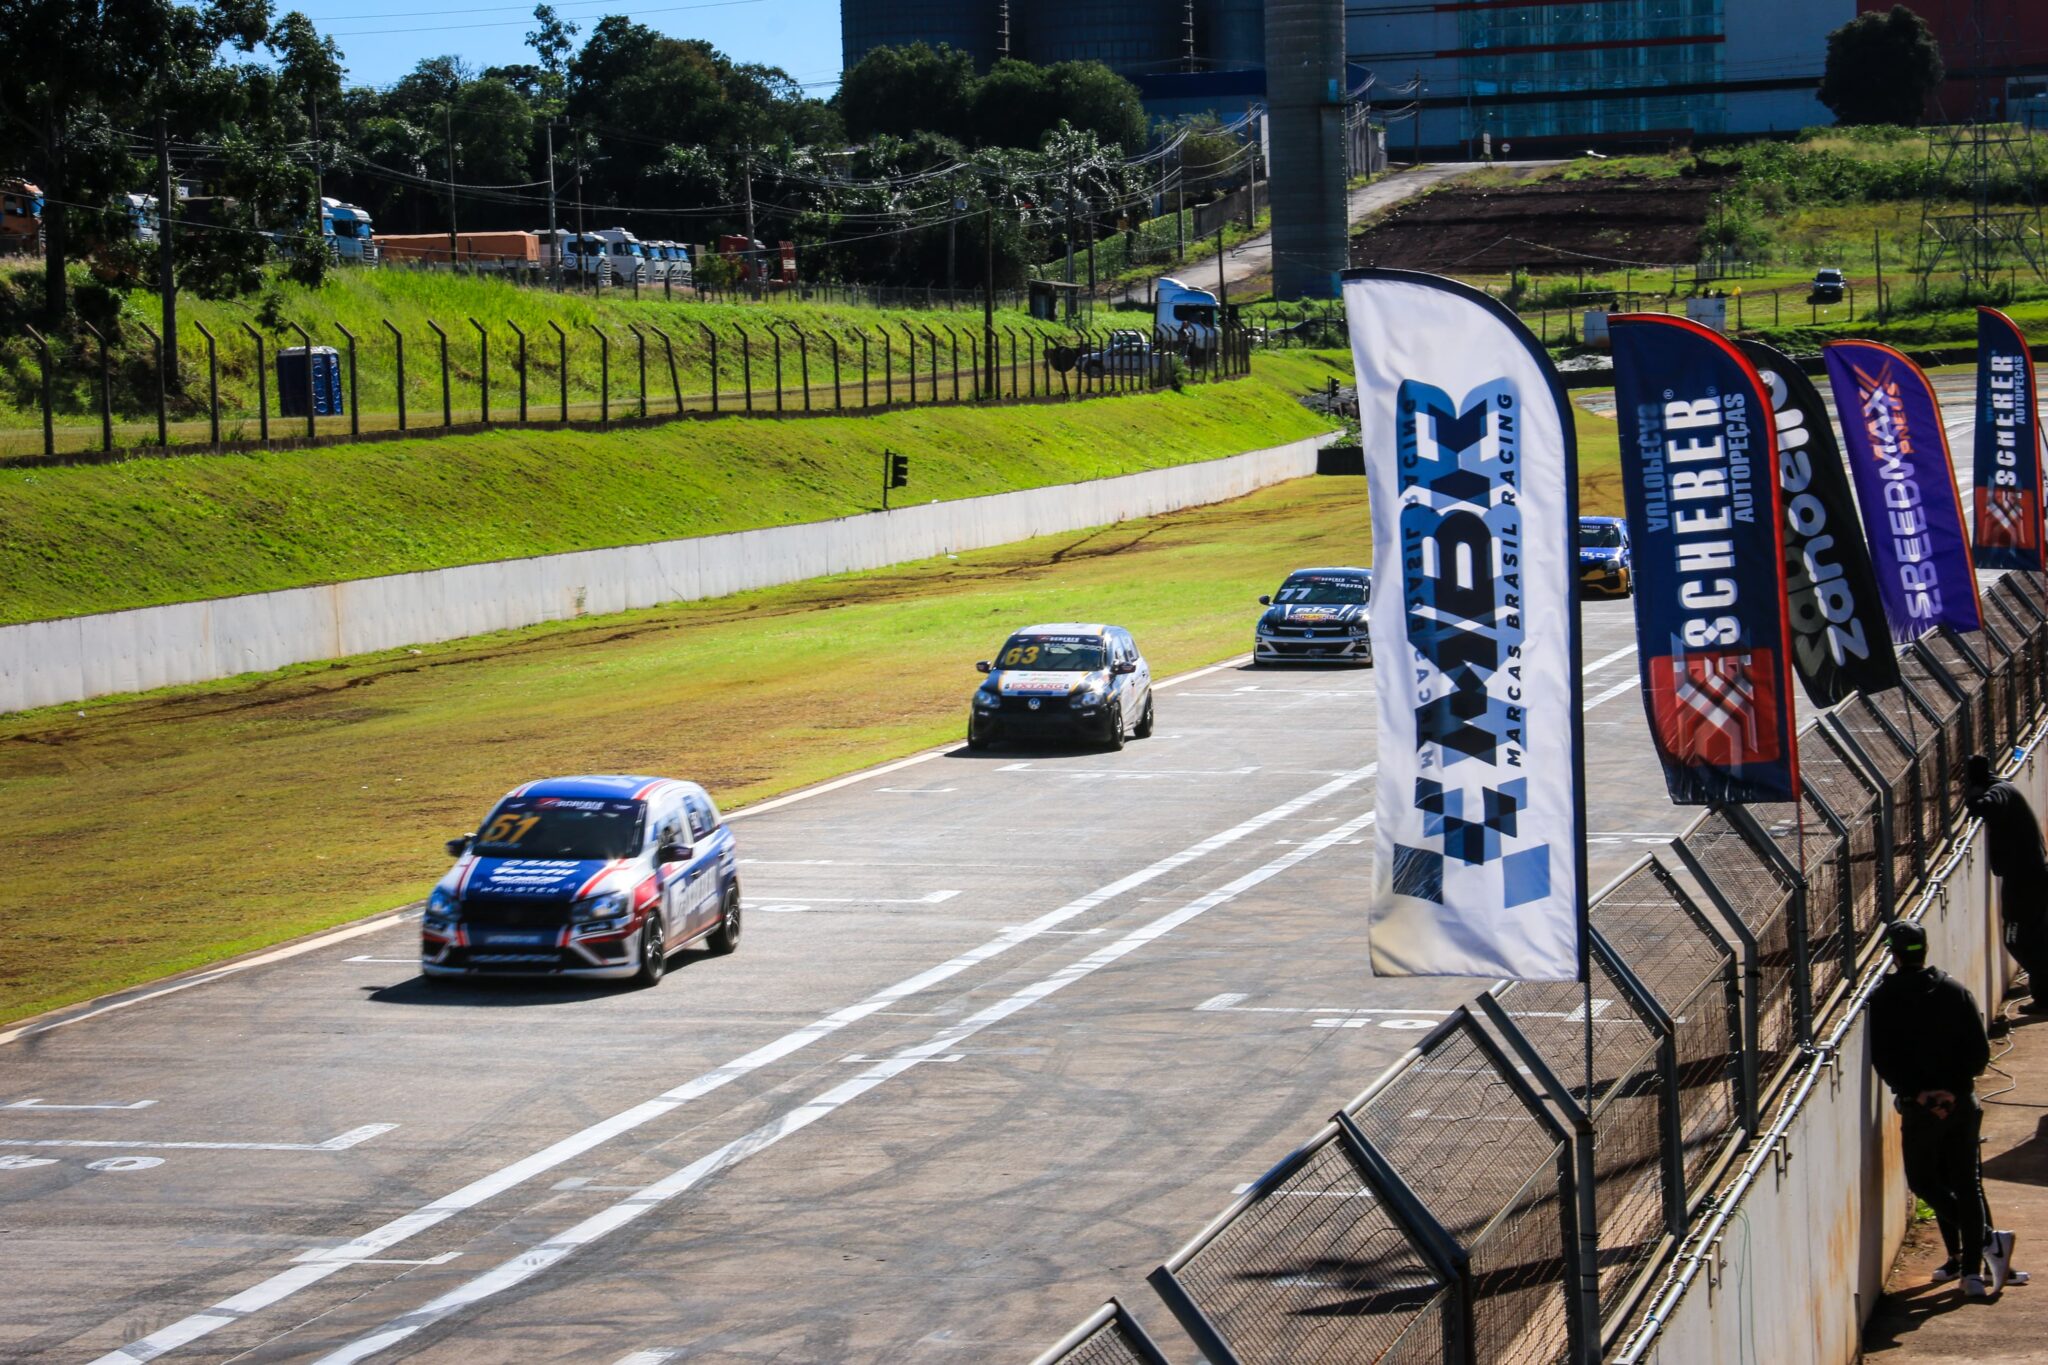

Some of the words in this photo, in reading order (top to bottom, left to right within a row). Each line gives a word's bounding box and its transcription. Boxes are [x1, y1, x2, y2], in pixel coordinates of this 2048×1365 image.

[1496, 393, 1517, 507] RACING
[1723, 392, 1755, 524] AUTOPEÇAS
[1991, 355, 2017, 486] SCHERER
[1501, 523, 1520, 630] BRASIL
[1664, 396, 1740, 648] SCHERER
[1004, 646, 1040, 666] 63
[1506, 645, 1522, 768] MARCAS
